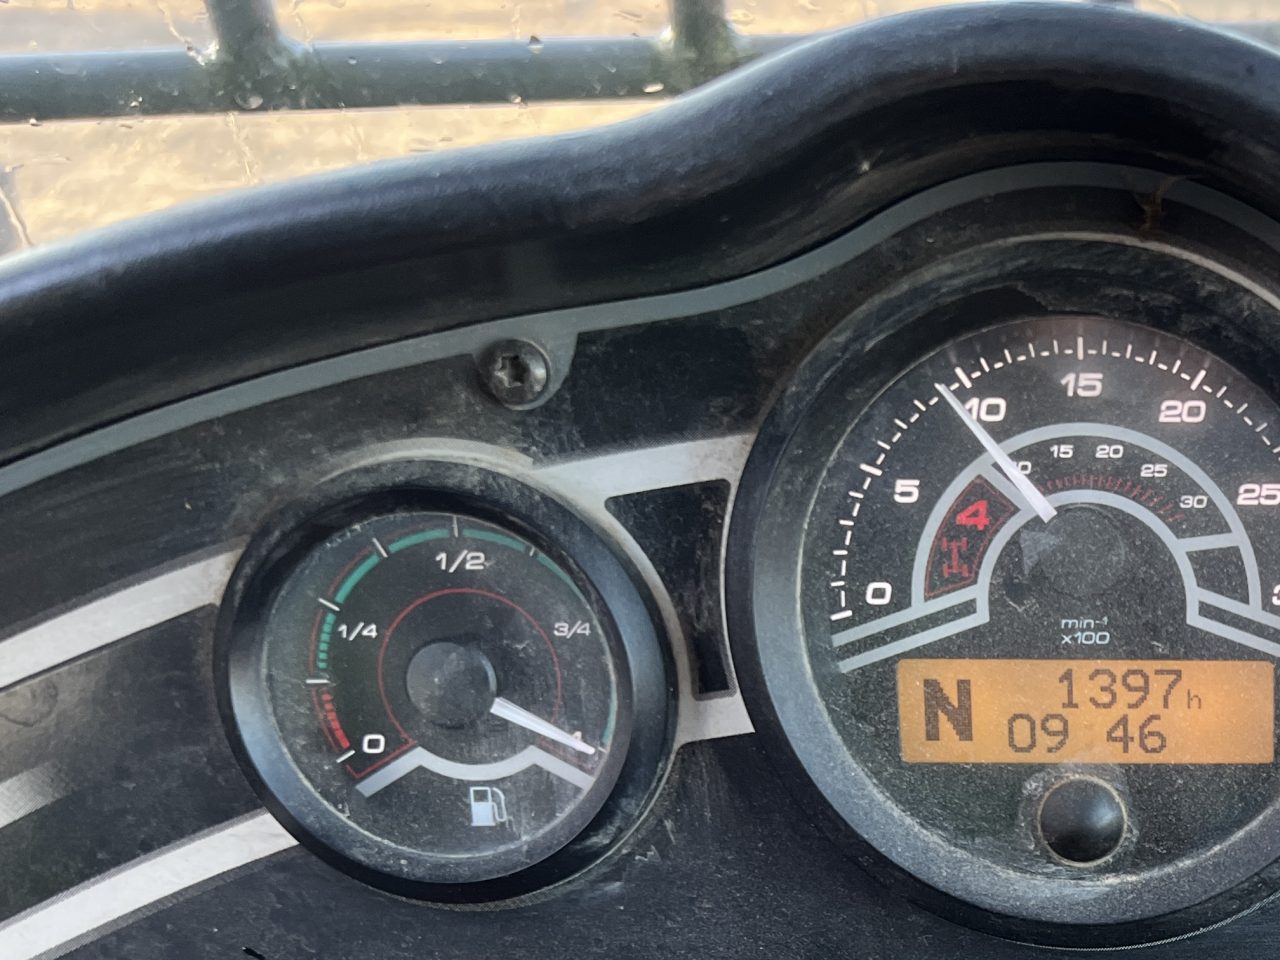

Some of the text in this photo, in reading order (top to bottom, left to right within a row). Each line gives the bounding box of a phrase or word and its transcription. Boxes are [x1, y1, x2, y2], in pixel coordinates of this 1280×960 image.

[1060, 373, 1103, 397] 15
[965, 397, 1007, 422] 10
[1159, 400, 1206, 423] 20
[1050, 444, 1074, 458] 15
[1095, 444, 1124, 459] 20
[1140, 464, 1168, 478] 25
[894, 480, 920, 503] 5
[1180, 495, 1208, 509] 30
[955, 501, 990, 530] 4
[435, 549, 487, 573] 1/2
[864, 581, 891, 605] 0
[338, 623, 378, 640] 1/4
[554, 620, 591, 637] 3/4
[1061, 631, 1110, 645] x100
[1058, 668, 1202, 710] 1397 h
[923, 679, 974, 741] N
[362, 734, 386, 754] 0
[1007, 713, 1167, 754] 09 46
